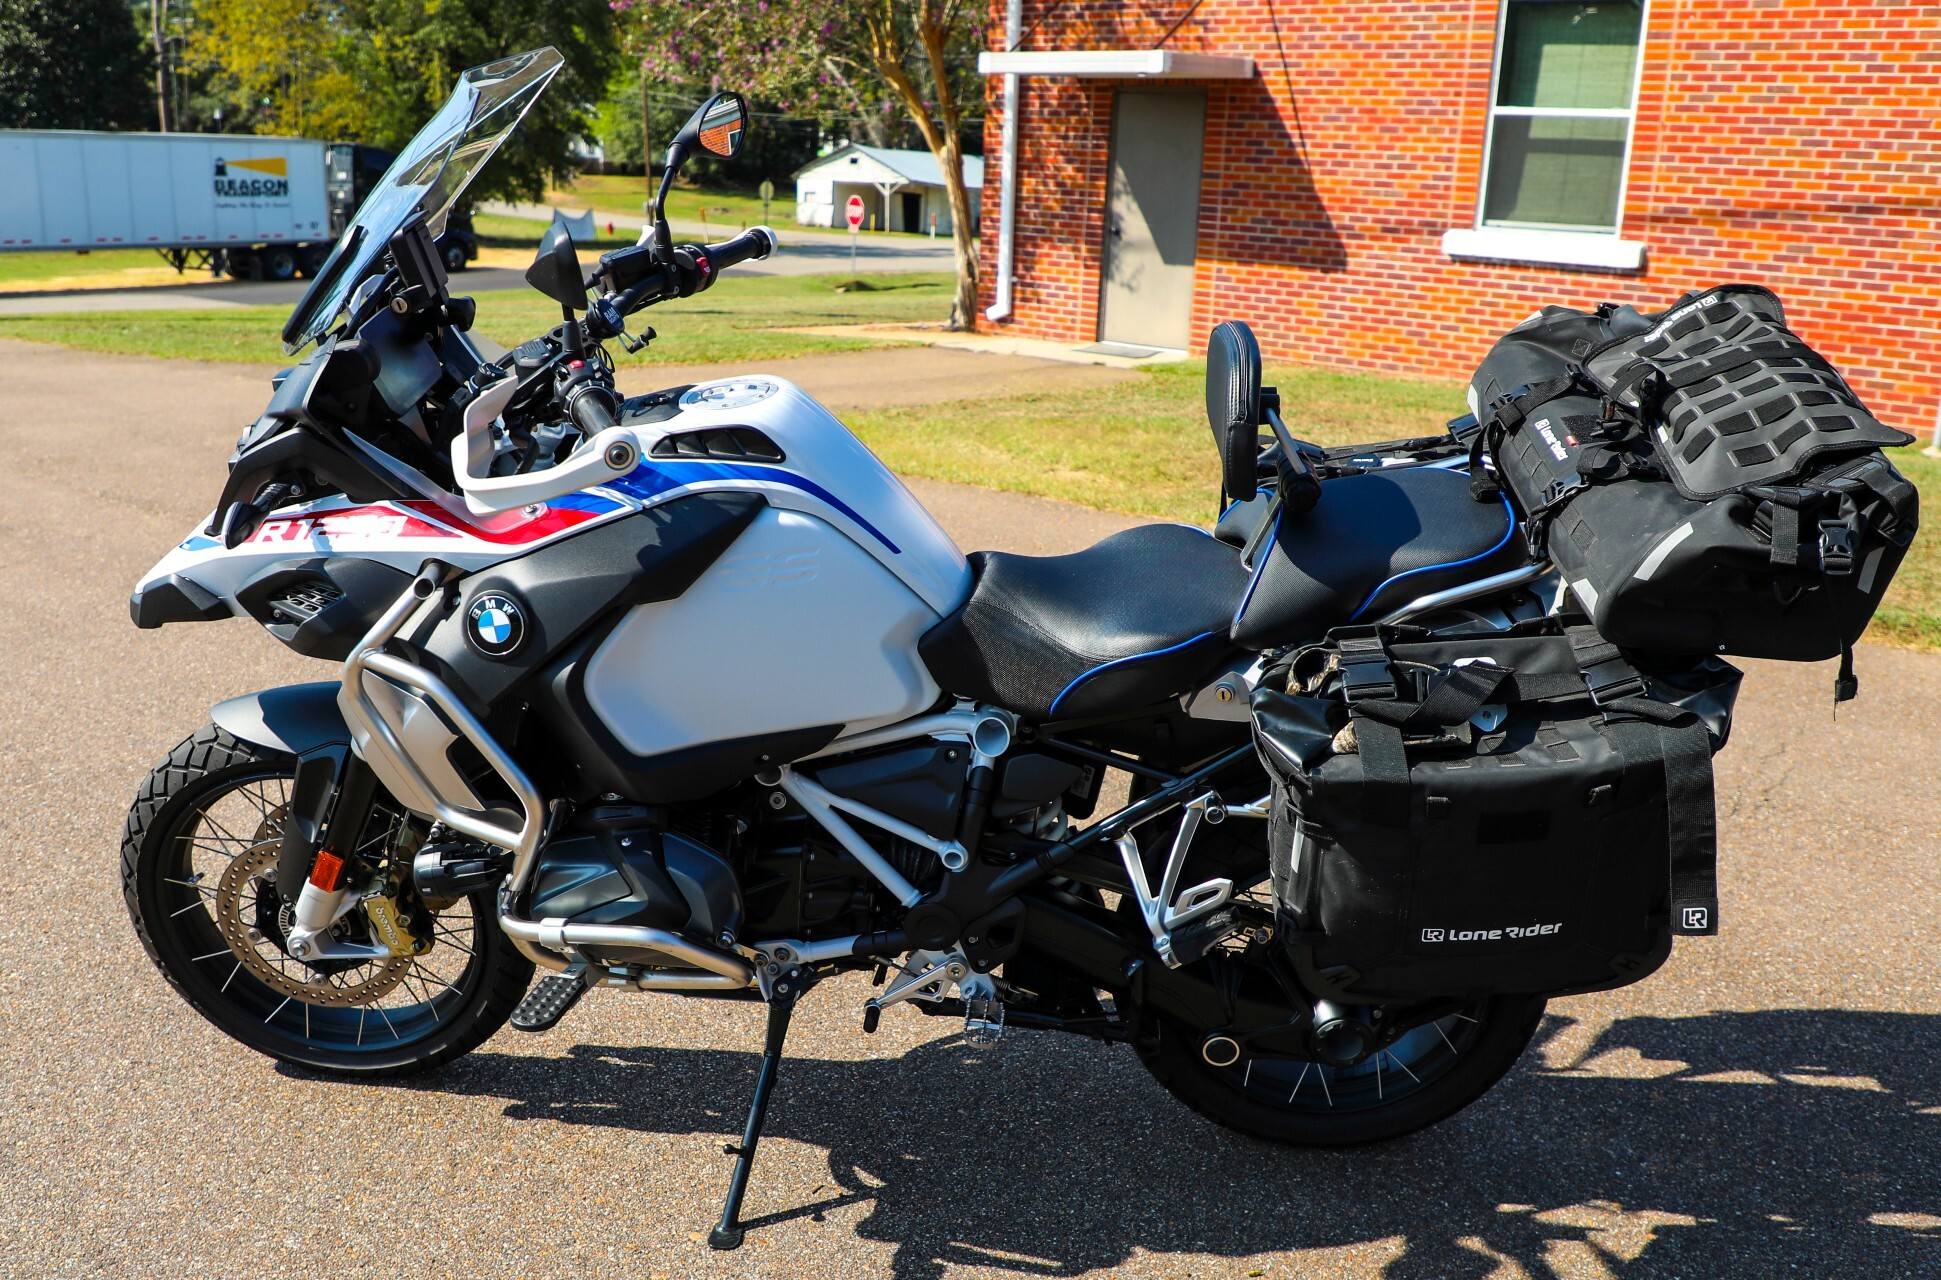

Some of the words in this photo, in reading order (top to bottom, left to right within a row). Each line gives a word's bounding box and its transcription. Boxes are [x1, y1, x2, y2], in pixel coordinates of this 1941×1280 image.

[213, 179, 288, 191] BEACON
[471, 599, 515, 620] BMW
[375, 906, 399, 946] brembo
[1449, 929, 1503, 941] Lone
[1505, 922, 1563, 939] Rider
